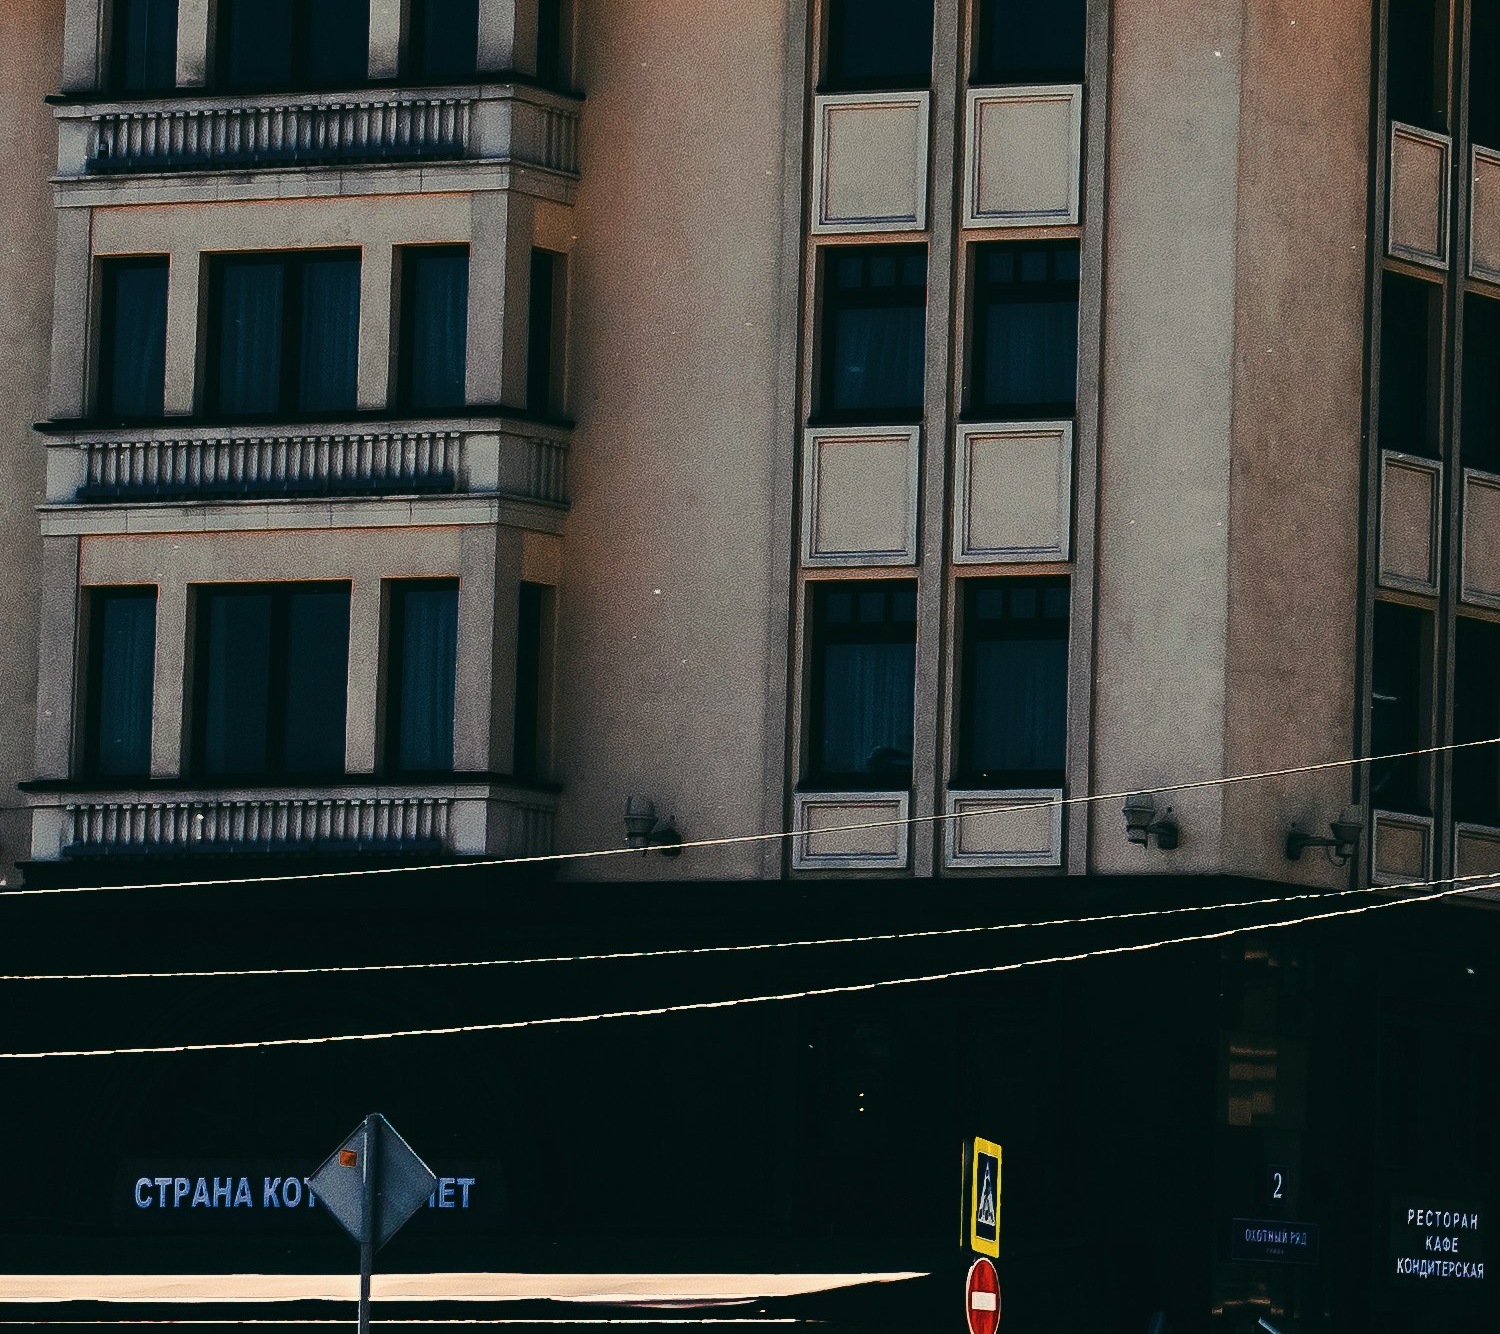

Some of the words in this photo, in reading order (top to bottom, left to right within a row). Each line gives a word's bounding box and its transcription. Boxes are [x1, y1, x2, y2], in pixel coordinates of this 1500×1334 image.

[134, 1176, 253, 1208] СТРАНА
[1273, 1172, 1282, 1198] 2
[1407, 1208, 1478, 1230] РЕСТОРАН
[1245, 1228, 1288, 1244] ОХОТНЫЙ
[1290, 1231, 1307, 1246] РЯД
[1425, 1235, 1459, 1253] КАФЕ
[1396, 1257, 1484, 1279] КОНДИТЕРСКАЯ
